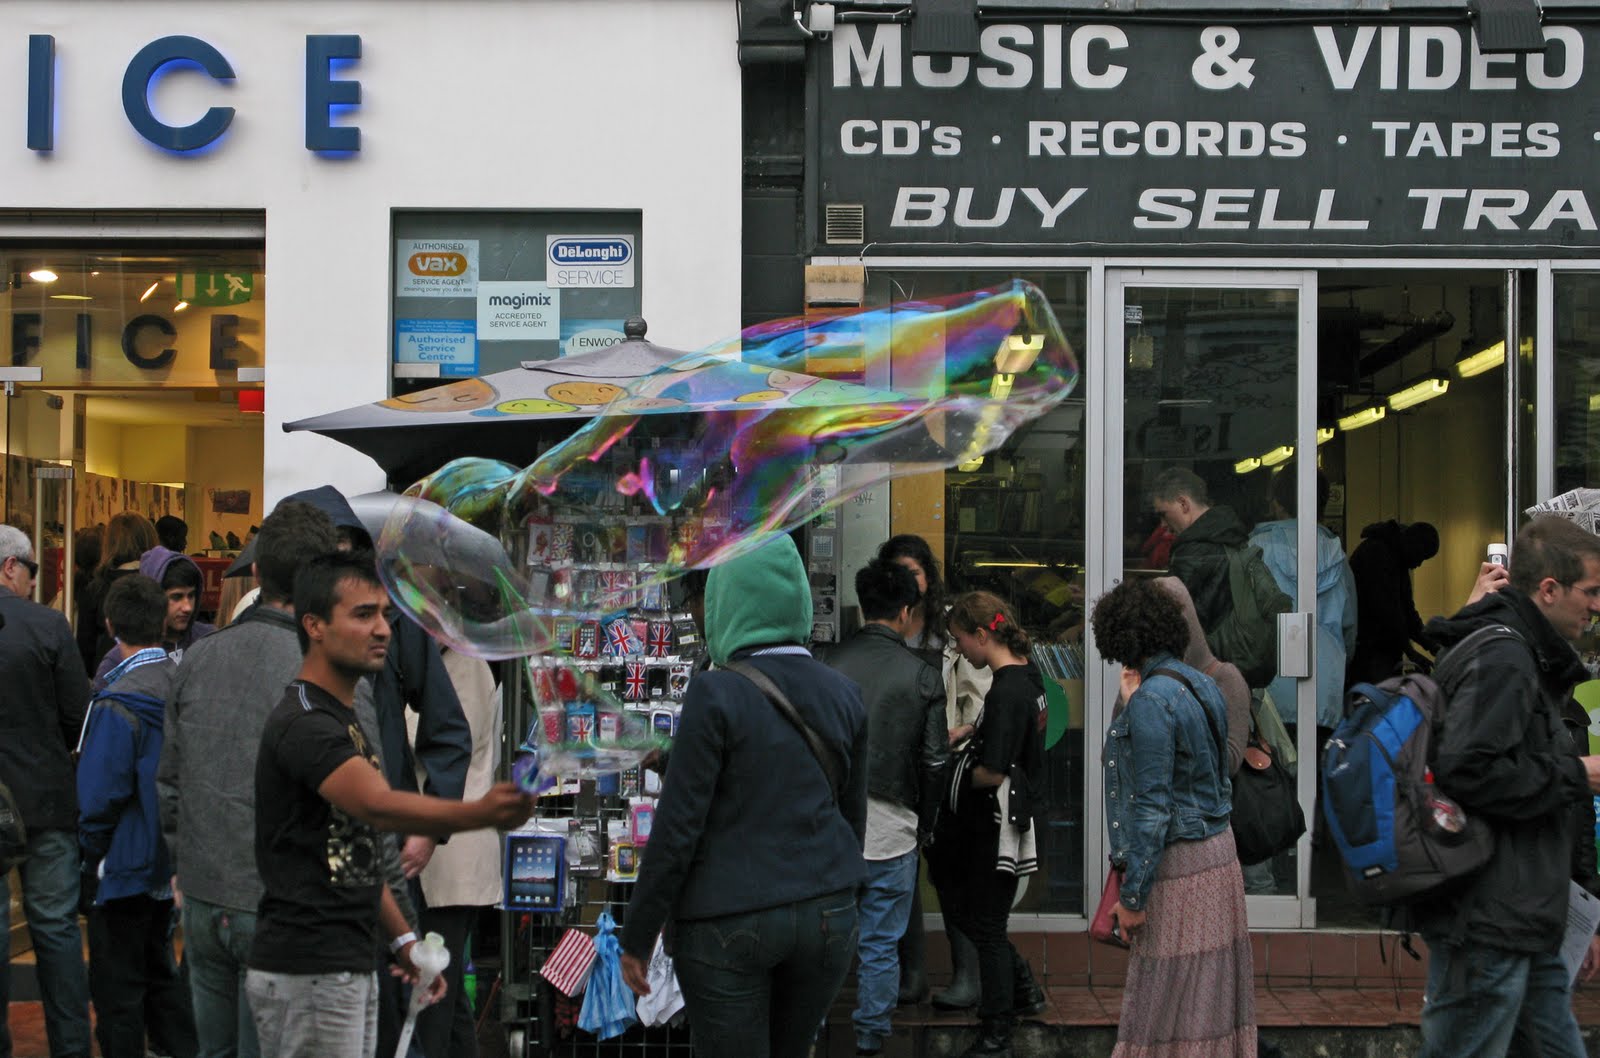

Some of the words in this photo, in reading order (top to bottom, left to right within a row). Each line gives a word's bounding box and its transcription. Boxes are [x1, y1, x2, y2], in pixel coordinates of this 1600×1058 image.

[832, 23, 1129, 89] MUSIC
[1191, 26, 1256, 90] &
[1312, 25, 1585, 90] VIDEO
[1028, 120, 1307, 157] RECORDS
[1371, 121, 1561, 158] TAPES
[890, 187, 1089, 228] BUY
[1133, 188, 1370, 230] SELL
[1407, 188, 1599, 231] TRA
[413, 242, 464, 251] AUTHORISED
[415, 256, 458, 272] vax
[557, 269, 624, 285] SERVICE
[441, 279, 465, 287] AGENT
[489, 293, 551, 310] magimix
[495, 312, 542, 320] ACCREDITED
[489, 320, 520, 328] SERVICE
[522, 320, 547, 328] AGENT
[408, 335, 466, 344] Authorised
[417, 343, 456, 352] Service
[418, 352, 456, 361] Centre
